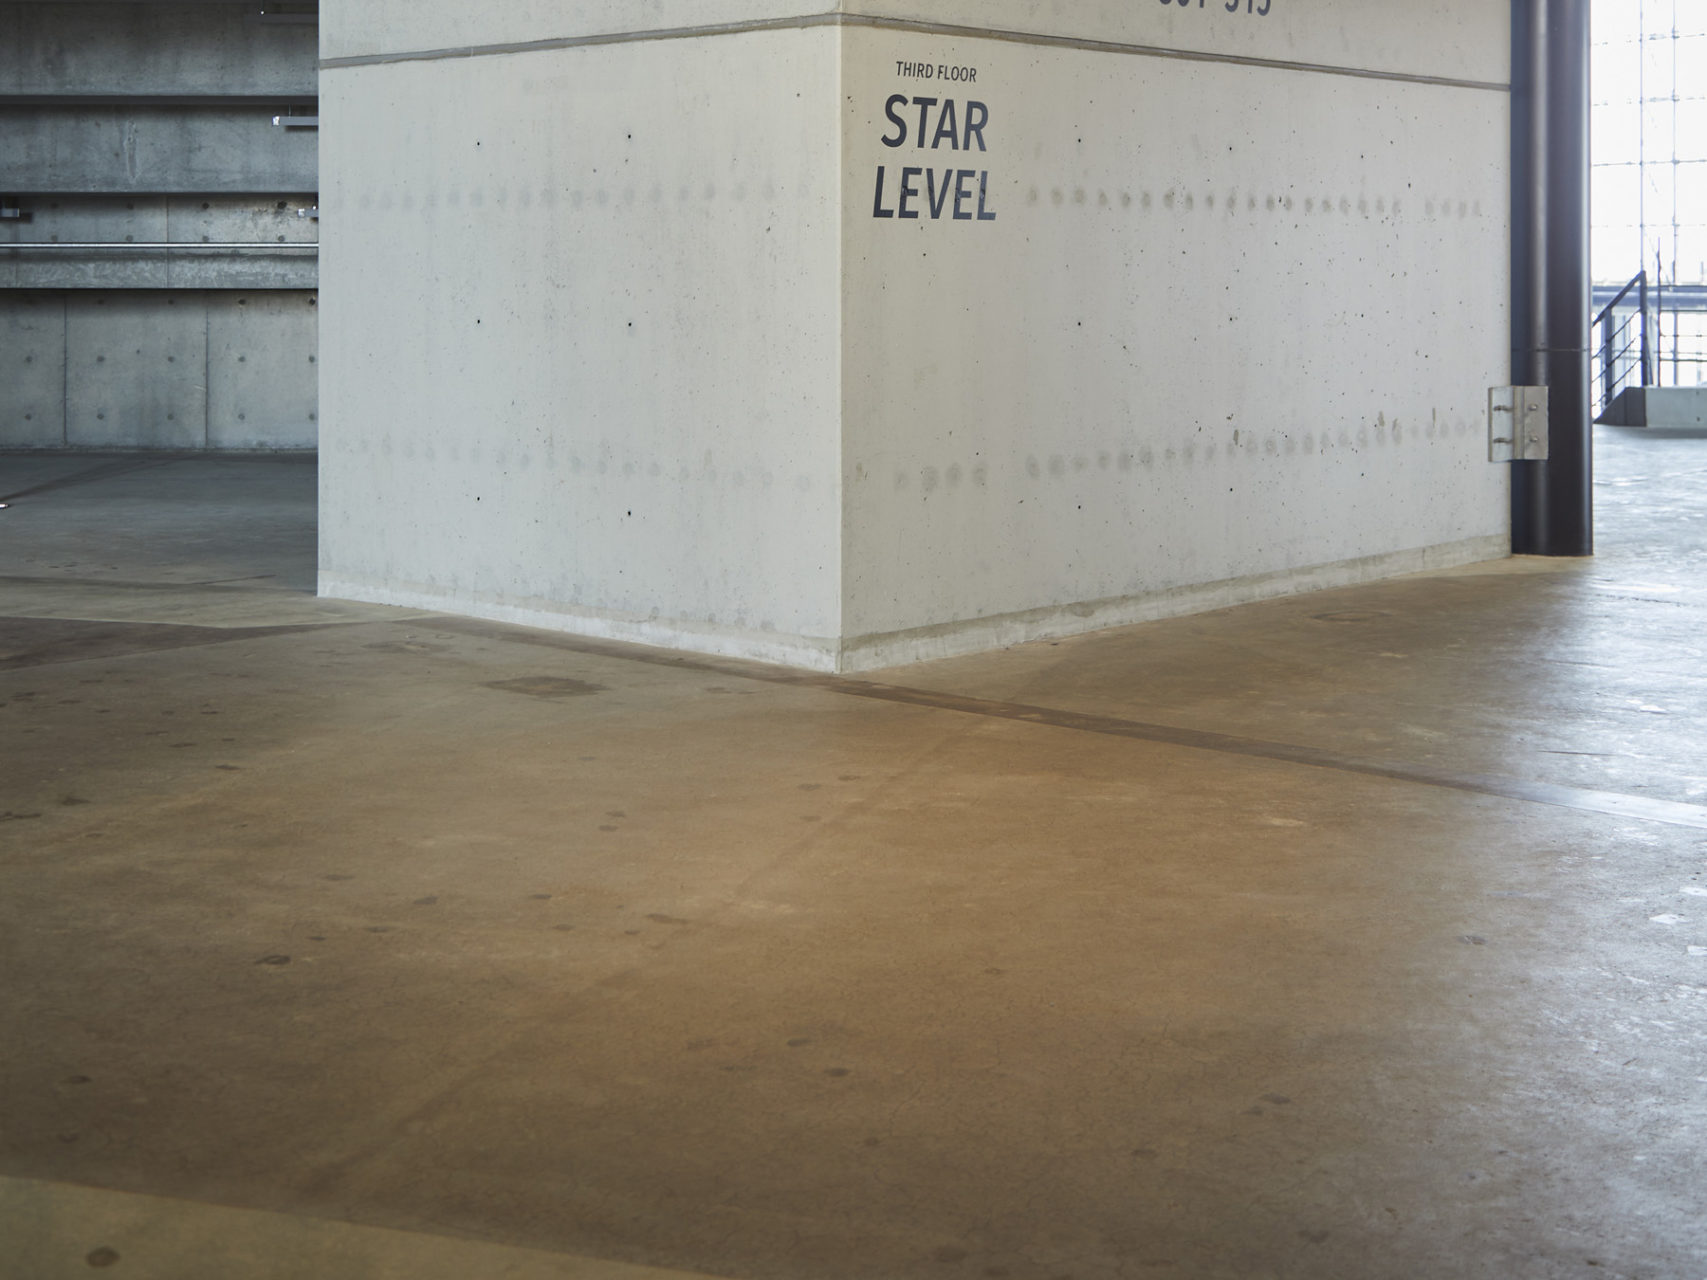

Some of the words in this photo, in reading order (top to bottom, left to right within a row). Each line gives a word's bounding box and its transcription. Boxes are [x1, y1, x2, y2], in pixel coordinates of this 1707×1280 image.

[895, 61, 934, 79] THIRD
[937, 65, 977, 83] FLOOR
[880, 94, 989, 152] STAR
[872, 166, 996, 221] LEVEL
